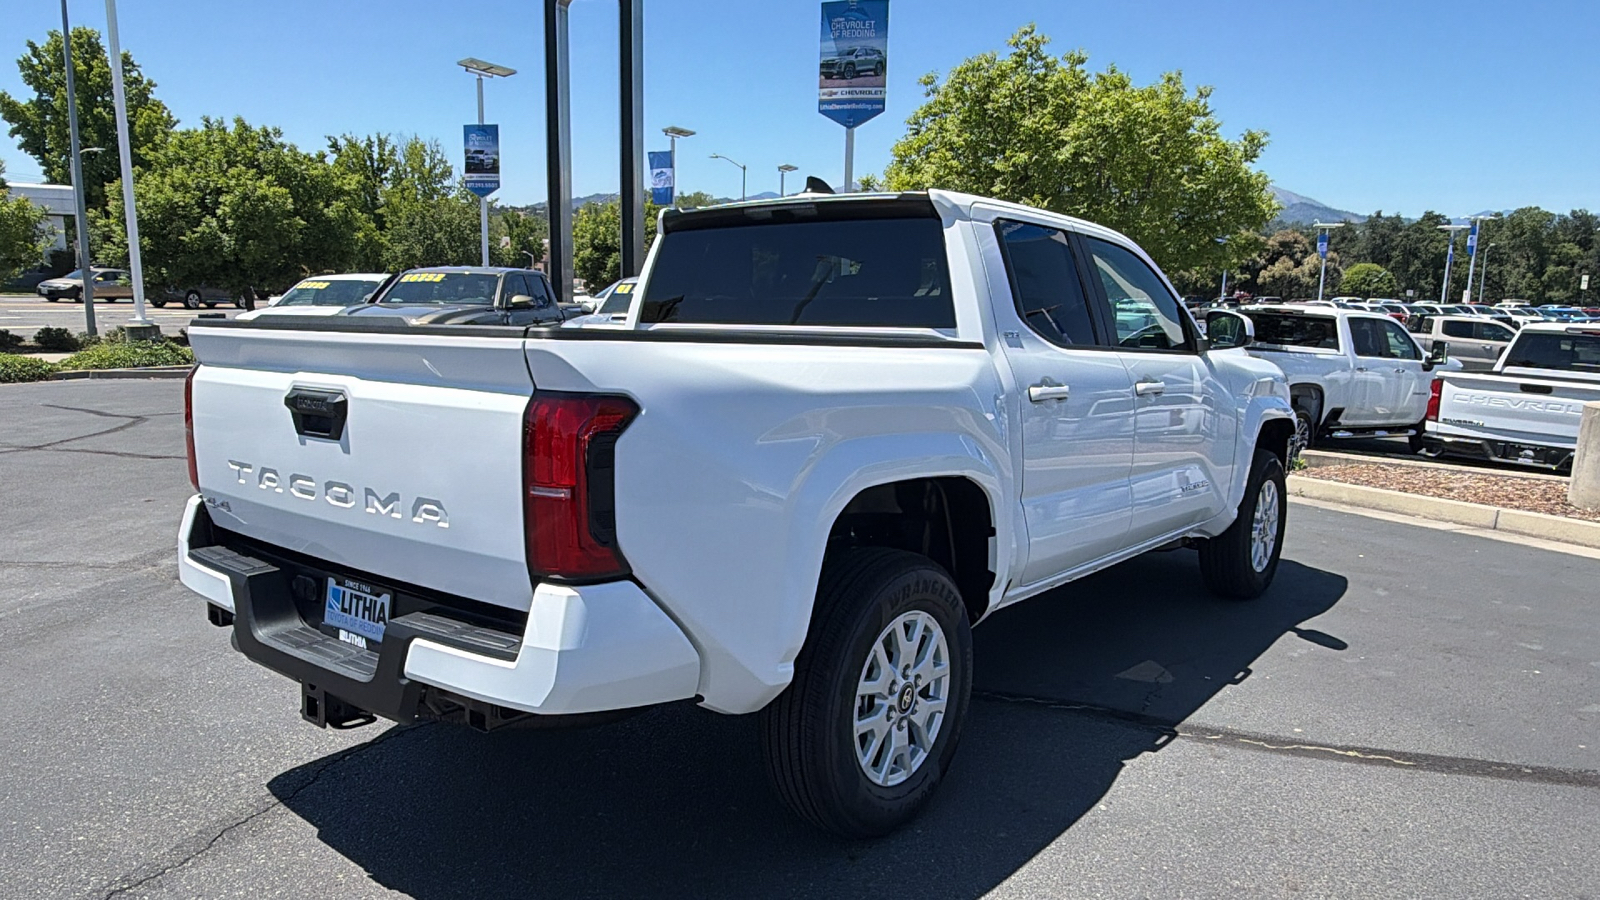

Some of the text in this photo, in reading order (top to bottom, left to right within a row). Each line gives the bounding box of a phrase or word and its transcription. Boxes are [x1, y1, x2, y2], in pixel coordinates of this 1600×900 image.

[831, 20, 875, 30] CHEVROLET
[831, 29, 876, 39] OF REDDING
[1453, 393, 1583, 415] CHEVROL
[228, 459, 449, 528] TACOMA
[345, 580, 359, 590] SINCE
[887, 579, 960, 611] WRANGLER
[341, 590, 387, 625] LITHIA
[327, 611, 384, 635] TOYOTA OF REDDIN
[346, 631, 367, 649] LITHIA
